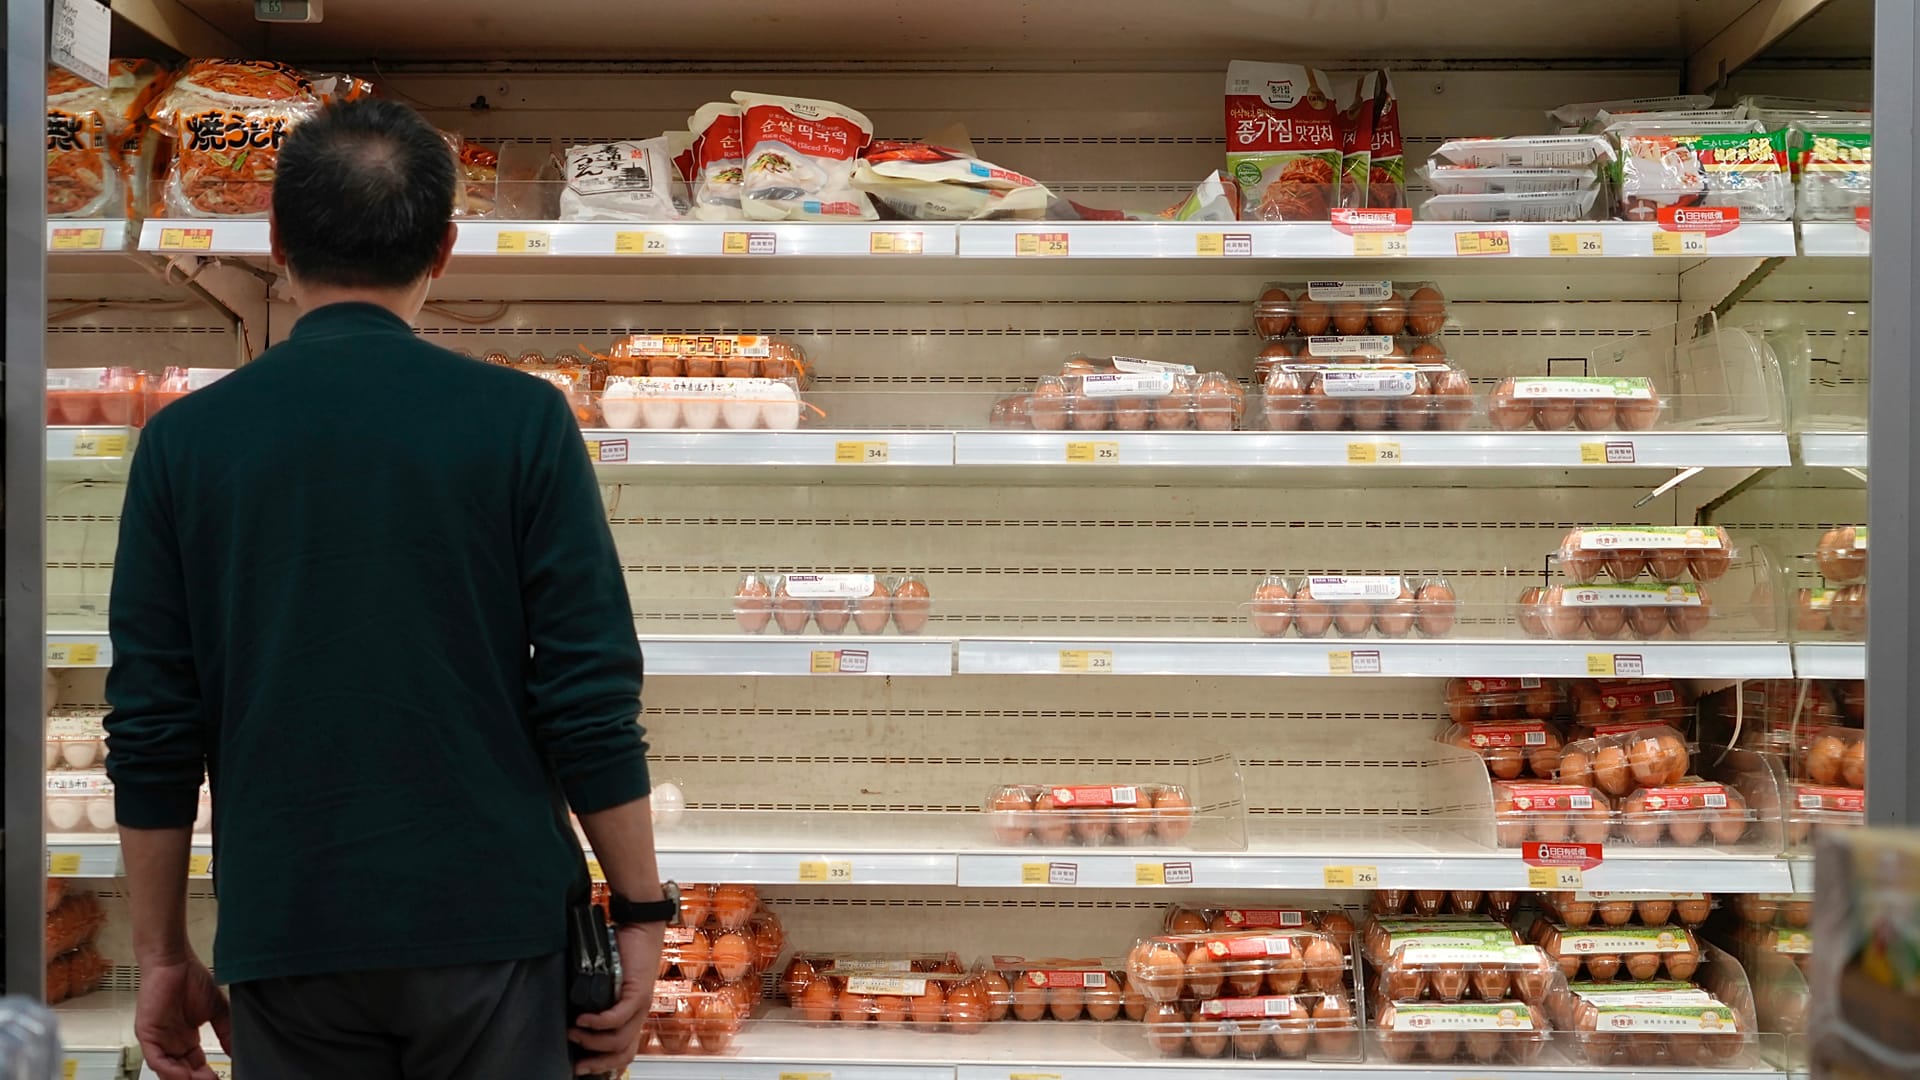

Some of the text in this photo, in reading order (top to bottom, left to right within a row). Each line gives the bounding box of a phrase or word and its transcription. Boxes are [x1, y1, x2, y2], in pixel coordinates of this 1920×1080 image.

[798, 124, 848, 145] 떡국떡
[1235, 118, 1334, 144] 종가집 맛김치
